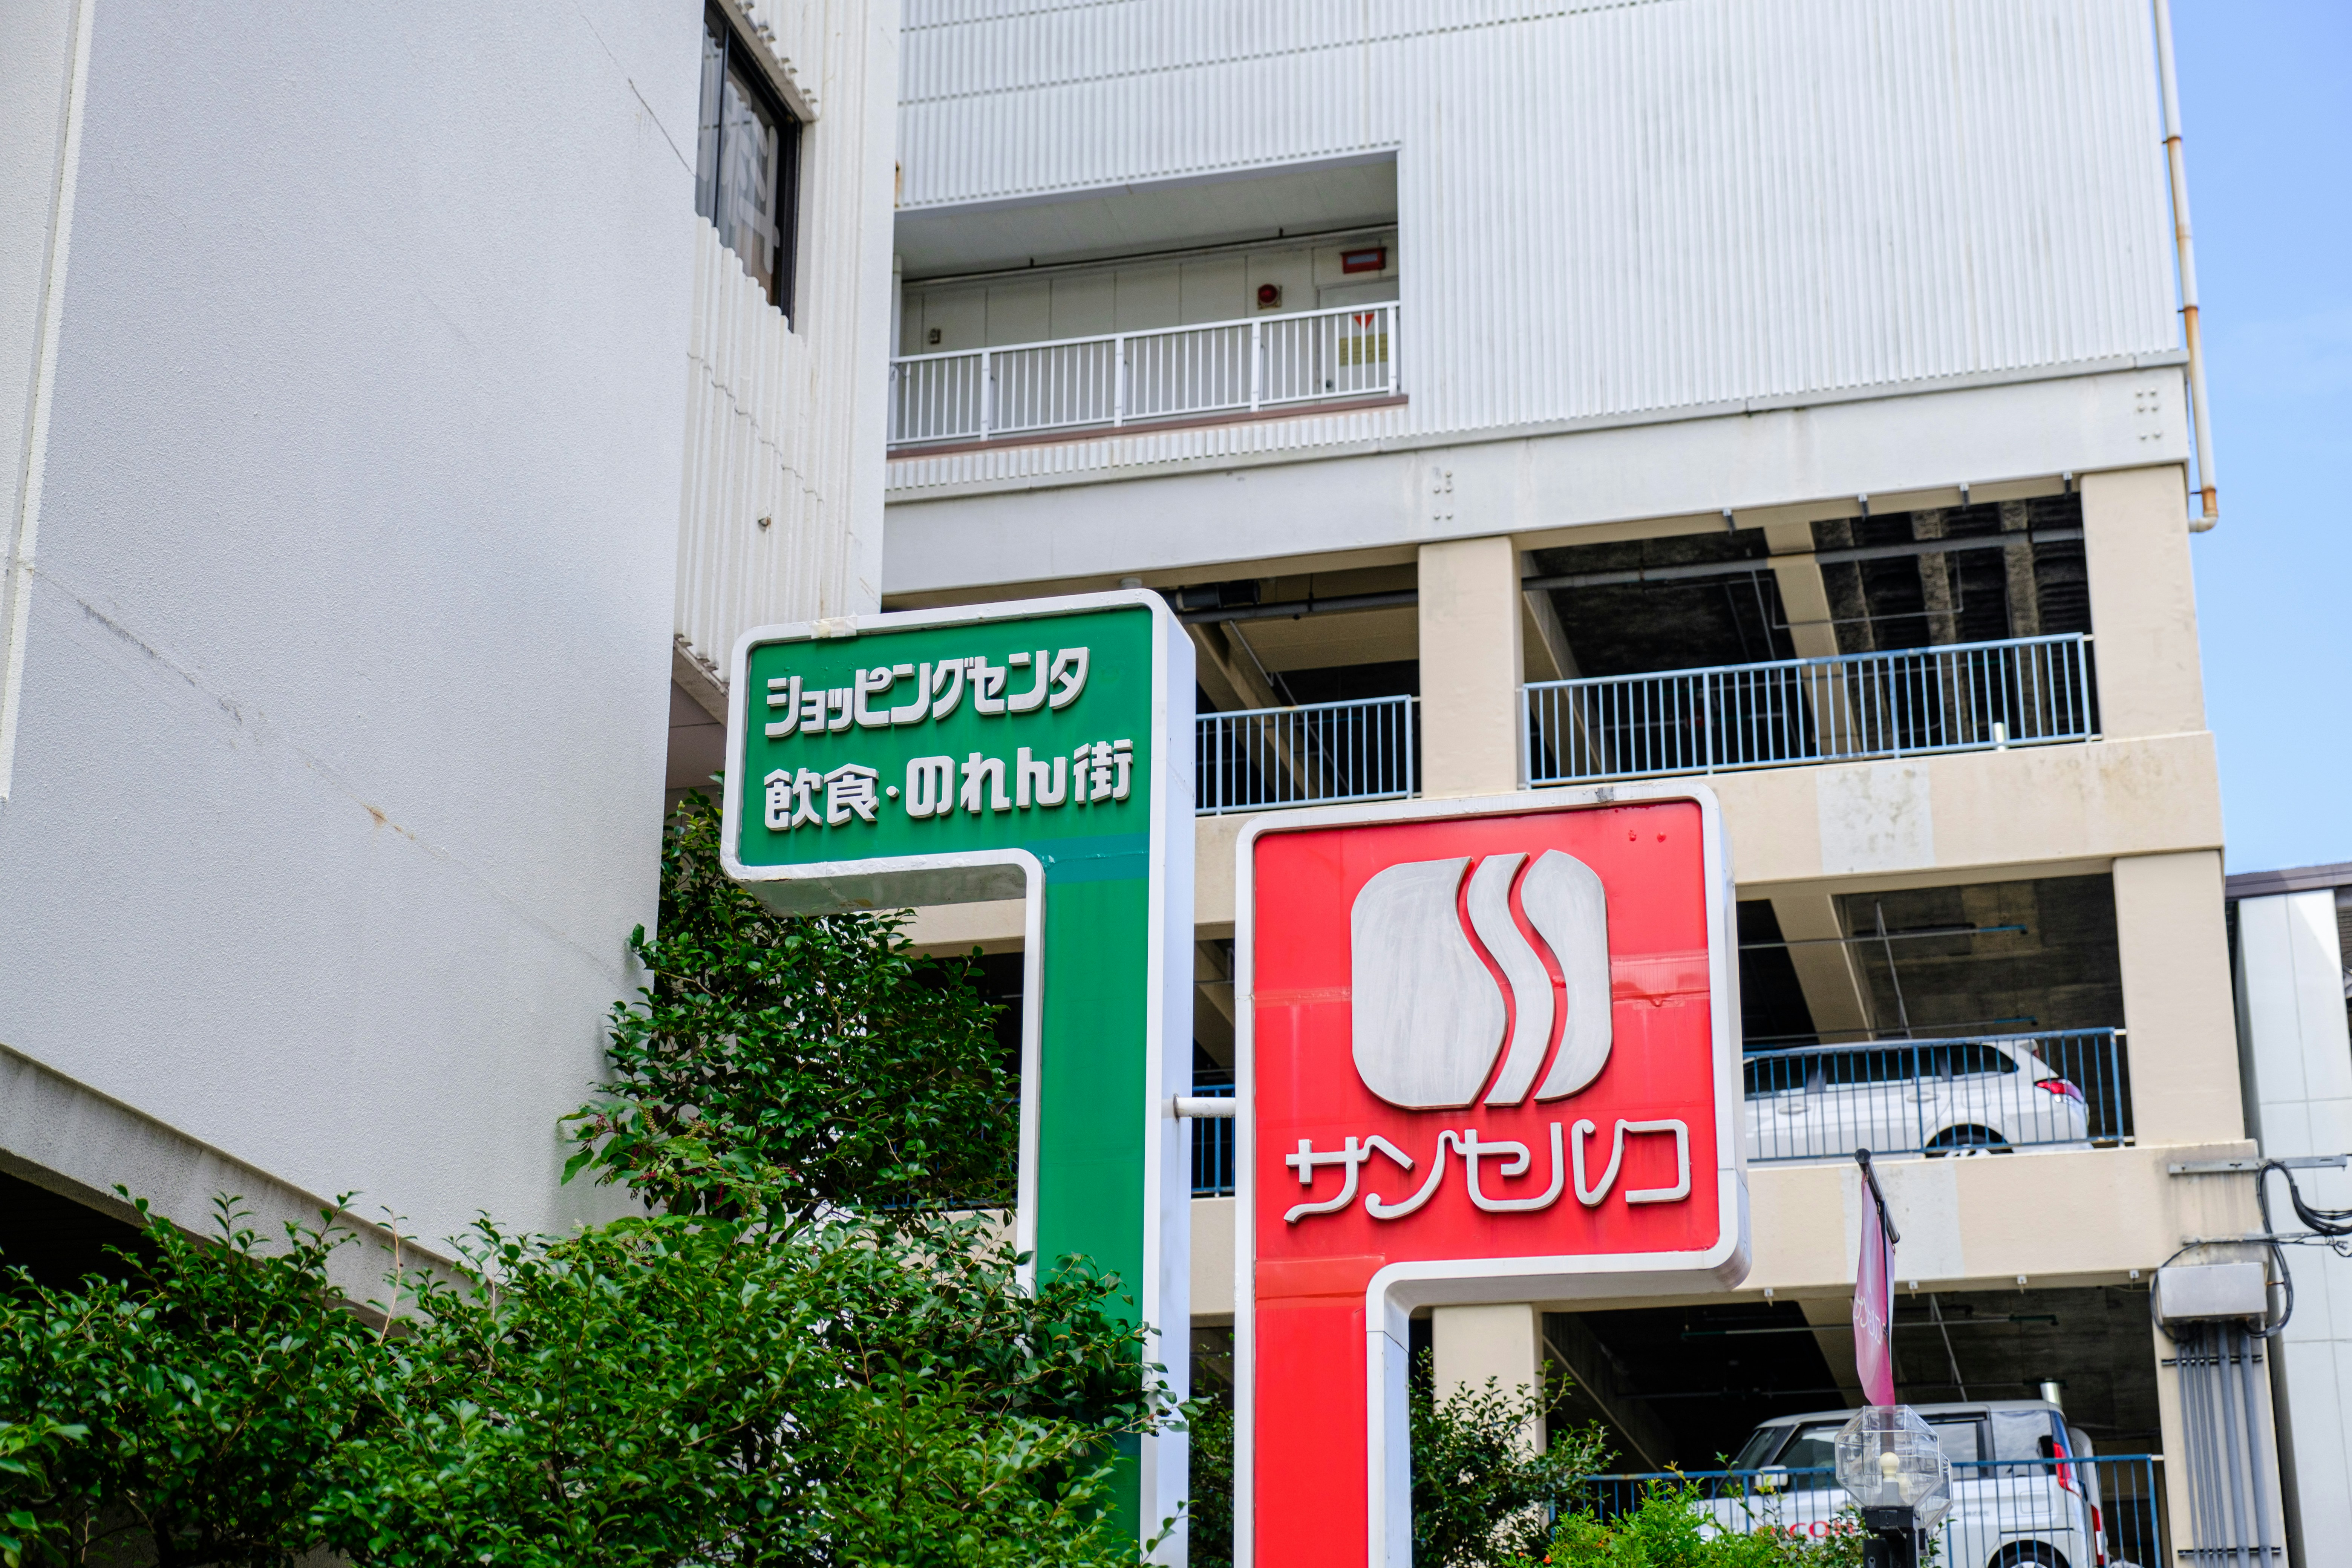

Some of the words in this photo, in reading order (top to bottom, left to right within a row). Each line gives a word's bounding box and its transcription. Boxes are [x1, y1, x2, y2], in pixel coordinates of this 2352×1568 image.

[765, 646, 1090, 737] ショッピングセンタ
[764, 739, 1134, 830] 飲食・のれん街
[1284, 1119, 1692, 1223] サンセルコ
